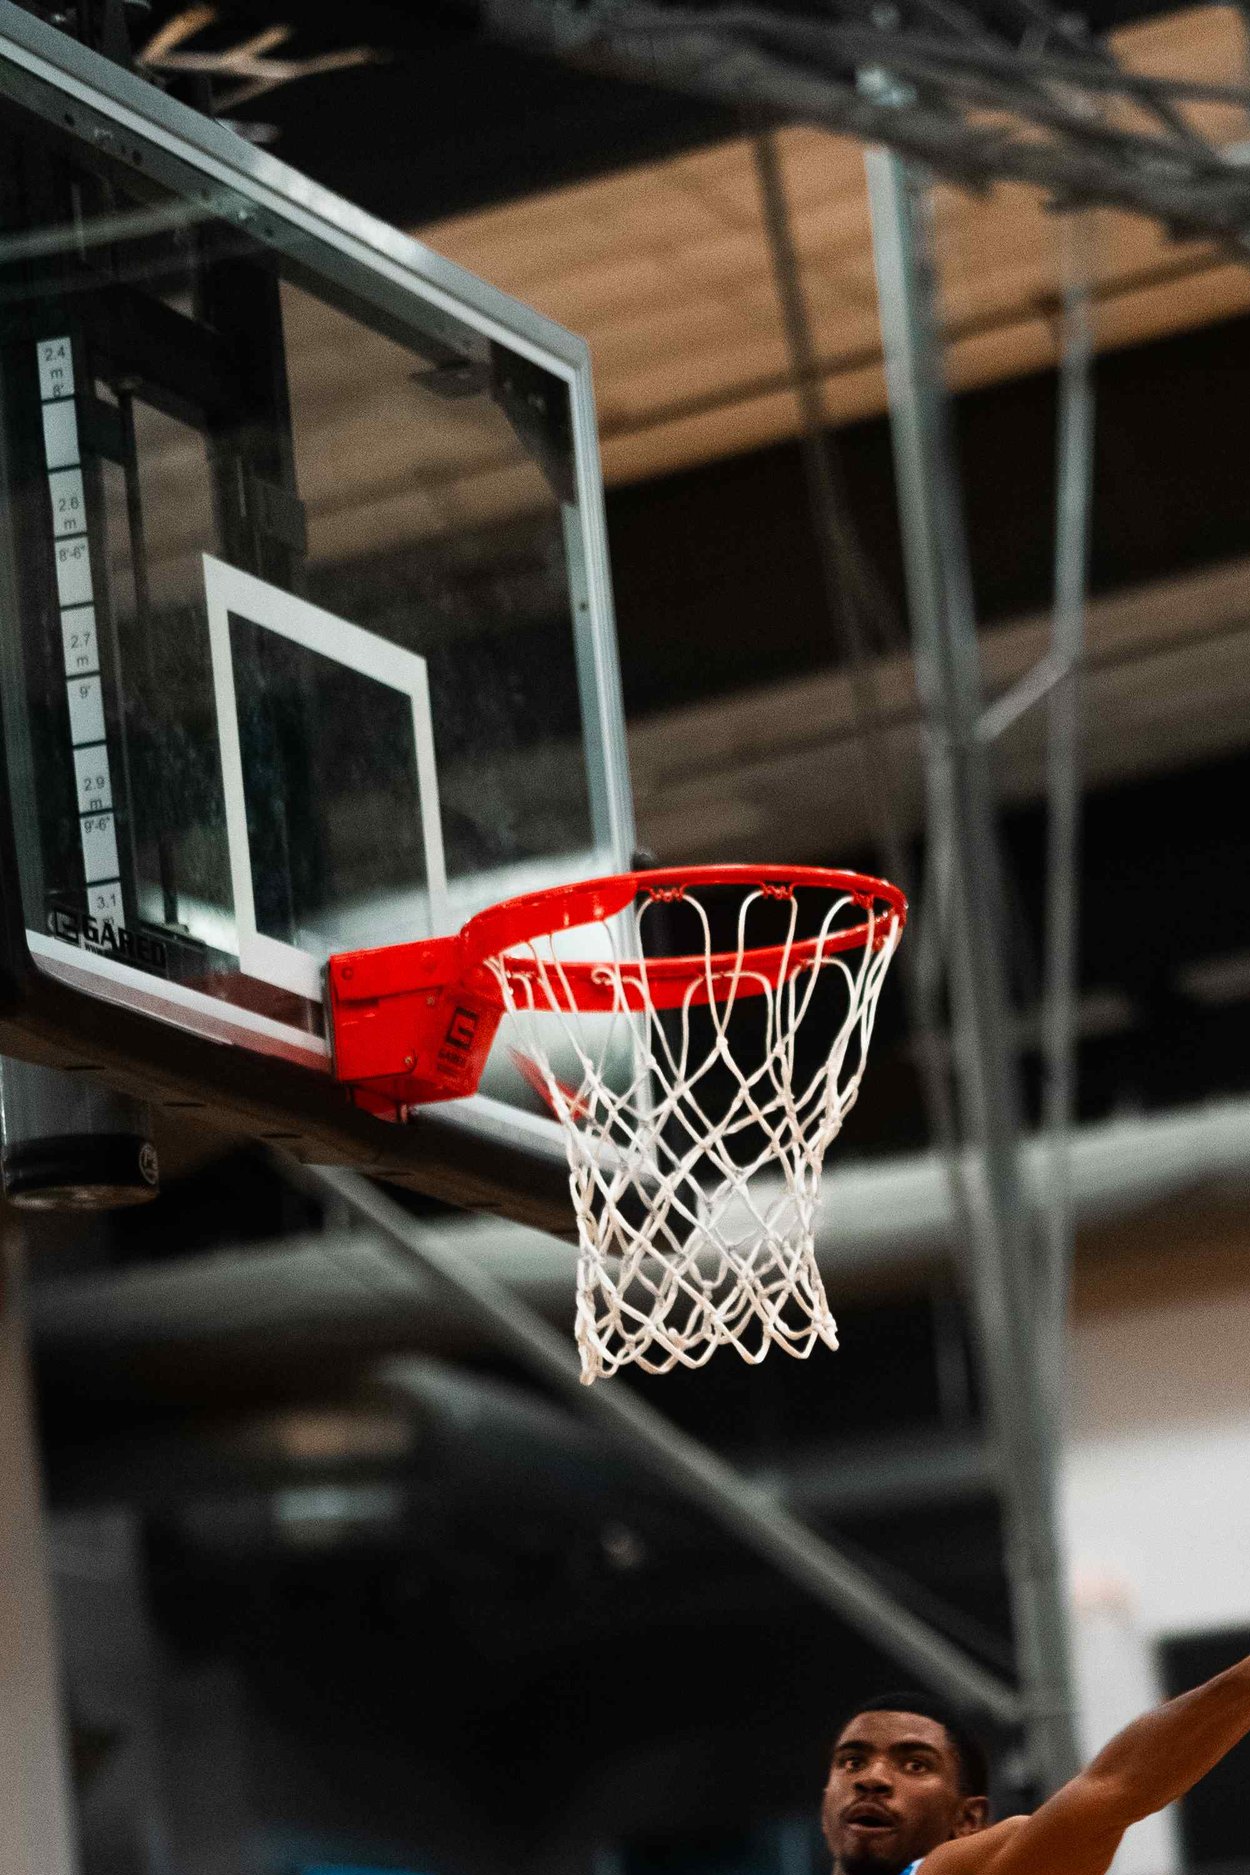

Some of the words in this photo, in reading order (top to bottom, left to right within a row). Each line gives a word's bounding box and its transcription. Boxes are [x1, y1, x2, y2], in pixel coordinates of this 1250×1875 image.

[44, 346, 65, 361] 2.4
[50, 367, 63, 379] m
[58, 496, 81, 512] 2.6
[64, 518, 77, 530] m
[70, 631, 91, 649] 2.7
[76, 655, 89, 667] m
[84, 776, 105, 792] 2.9
[96, 893, 117, 910] 3.1
